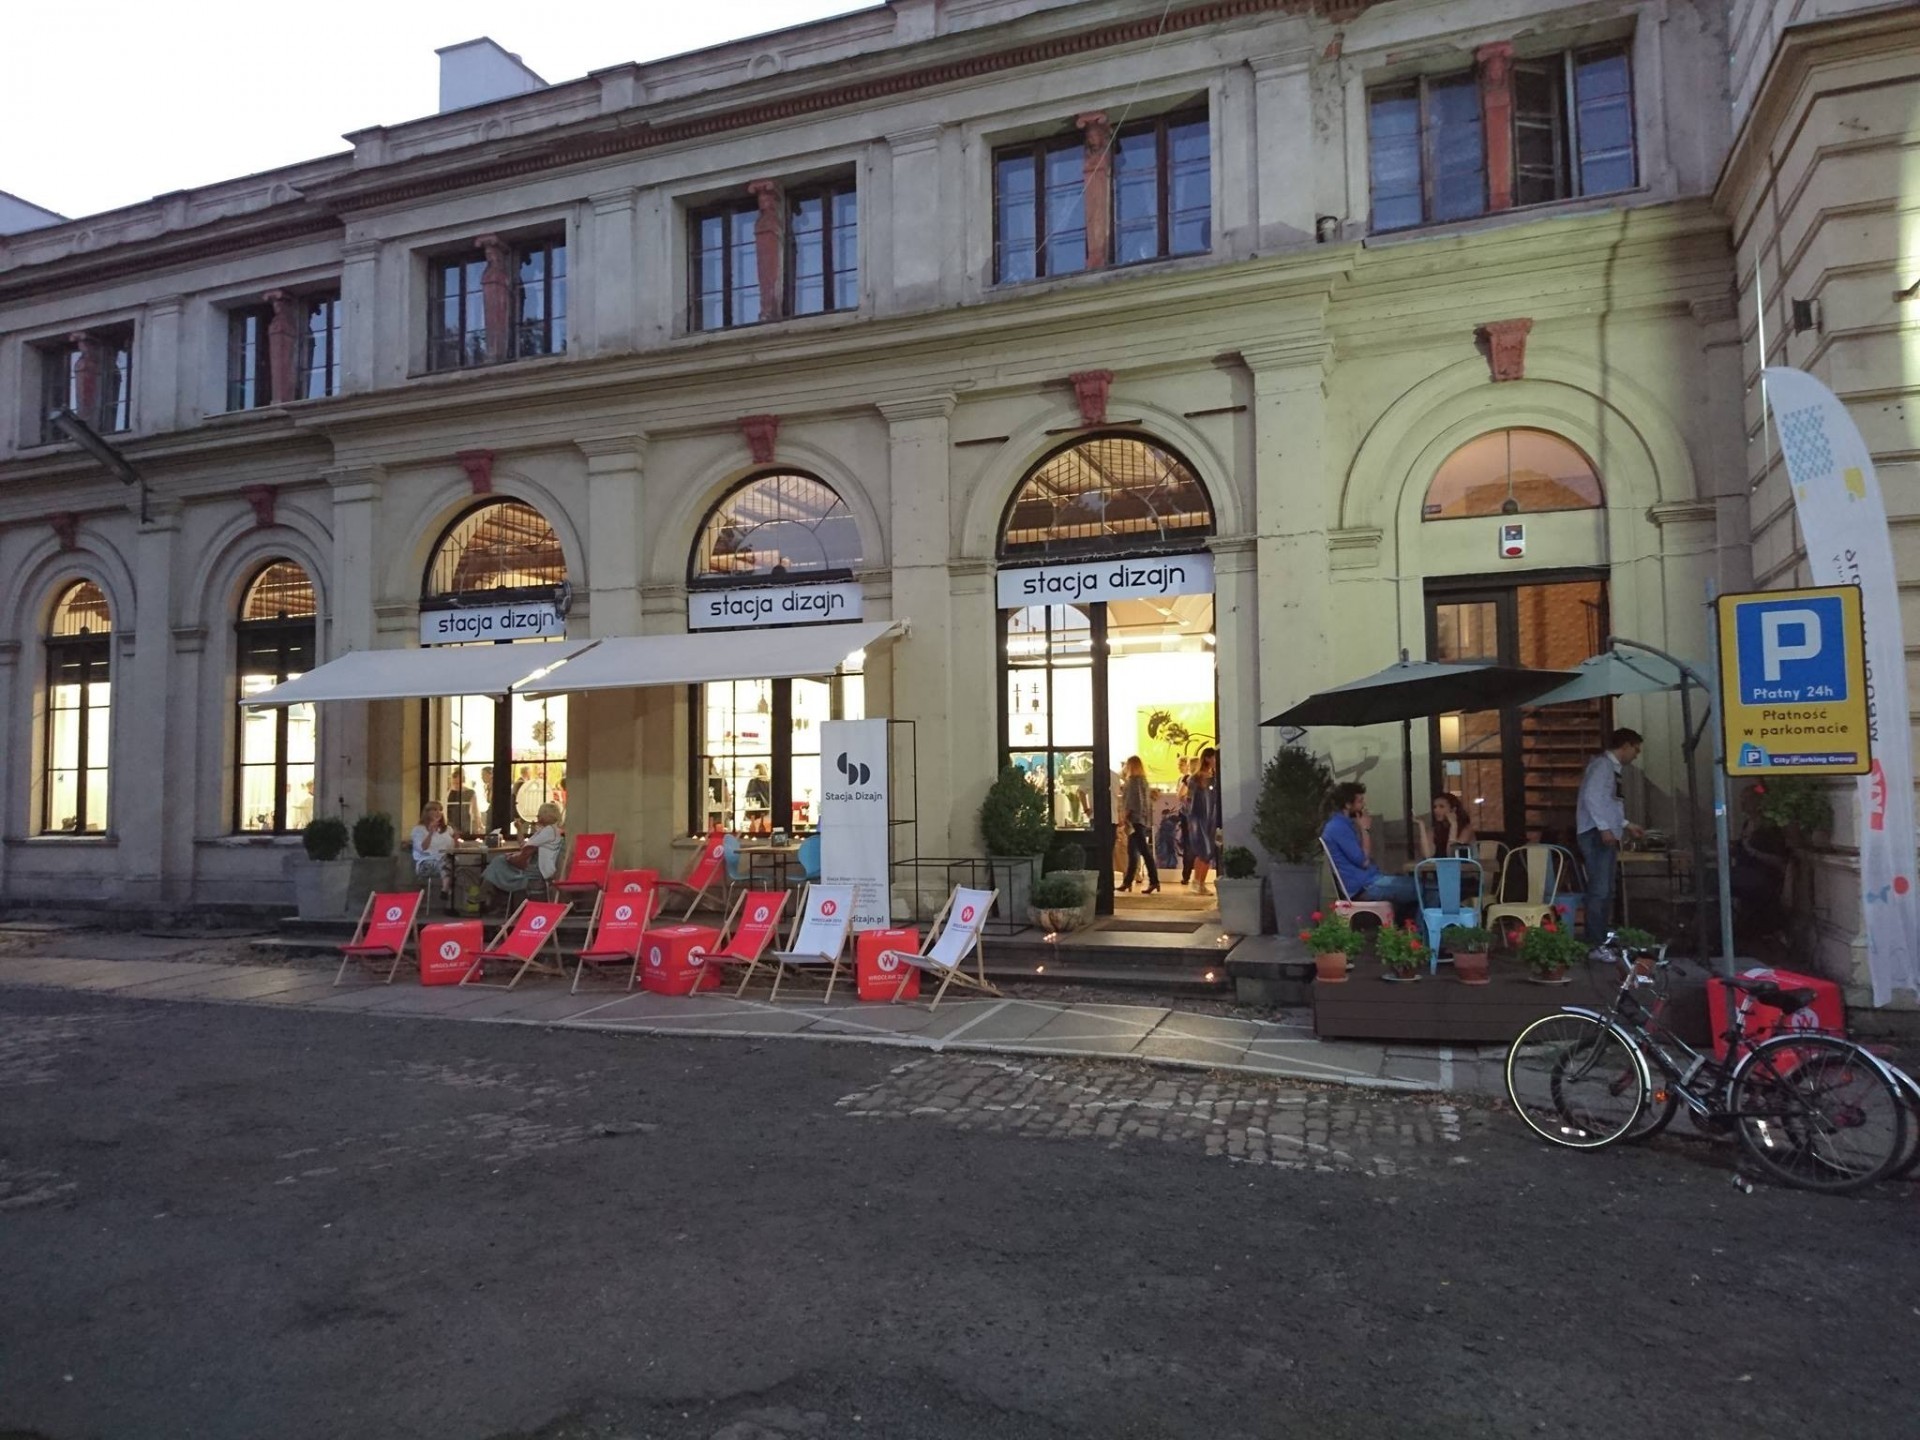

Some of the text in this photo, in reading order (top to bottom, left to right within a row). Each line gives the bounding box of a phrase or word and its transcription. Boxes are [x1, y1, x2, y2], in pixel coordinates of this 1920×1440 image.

[1023, 565, 1185, 600] stacja dizajn
[710, 590, 844, 621] stacja dizajn
[438, 609, 554, 638] stacja dizajn
[1761, 609, 1822, 681] P
[1753, 685, 1834, 700] Płatny 24h
[1762, 708, 1827, 721] Płatność
[1743, 723, 1849, 738] w parkomacie
[1747, 751, 1760, 763] P
[1773, 754, 1856, 765] City Parking Group
[825, 791, 882, 802] Stacja Dizajn
